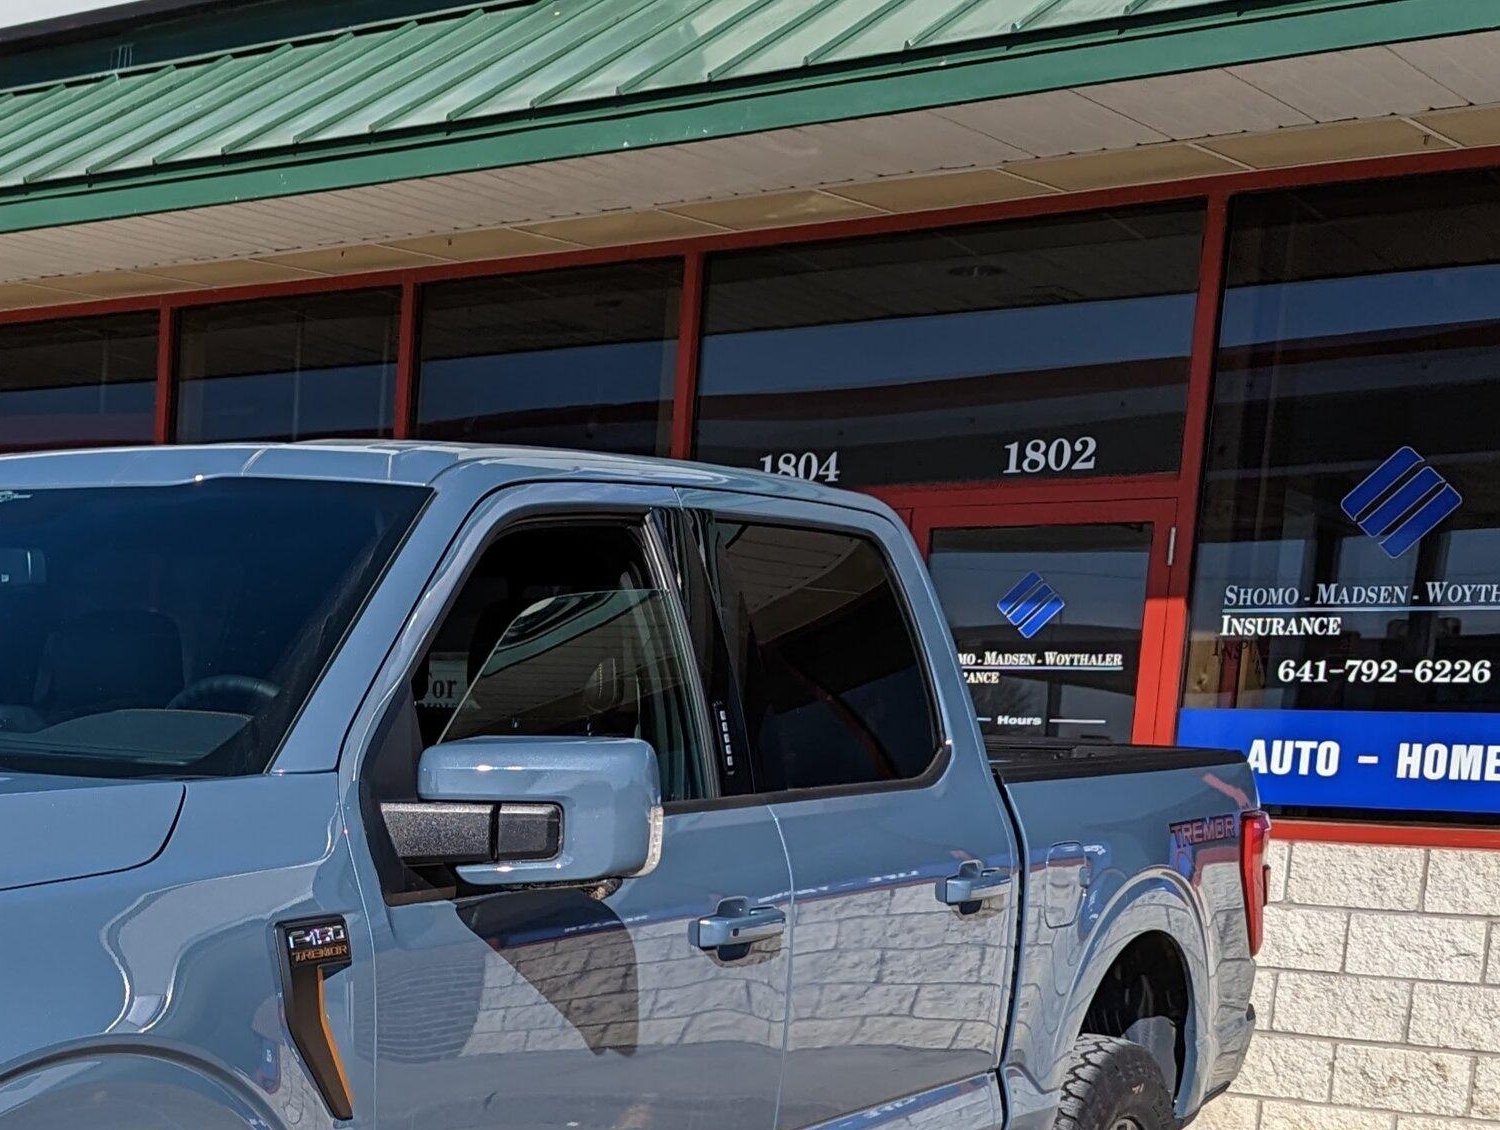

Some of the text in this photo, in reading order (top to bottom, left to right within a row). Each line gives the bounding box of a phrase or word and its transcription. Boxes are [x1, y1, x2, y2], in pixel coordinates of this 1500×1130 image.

[758, 451, 840, 482] 1804
[1002, 436, 1098, 474] 1802
[1277, 659, 1492, 684] 641-792-6226
[996, 715, 1042, 726] Hours
[1247, 739, 1341, 777] AUTO
[1396, 742, 1500, 782] HOME
[1169, 815, 1236, 848] TREMOR
[291, 944, 348, 962] TREMOR
